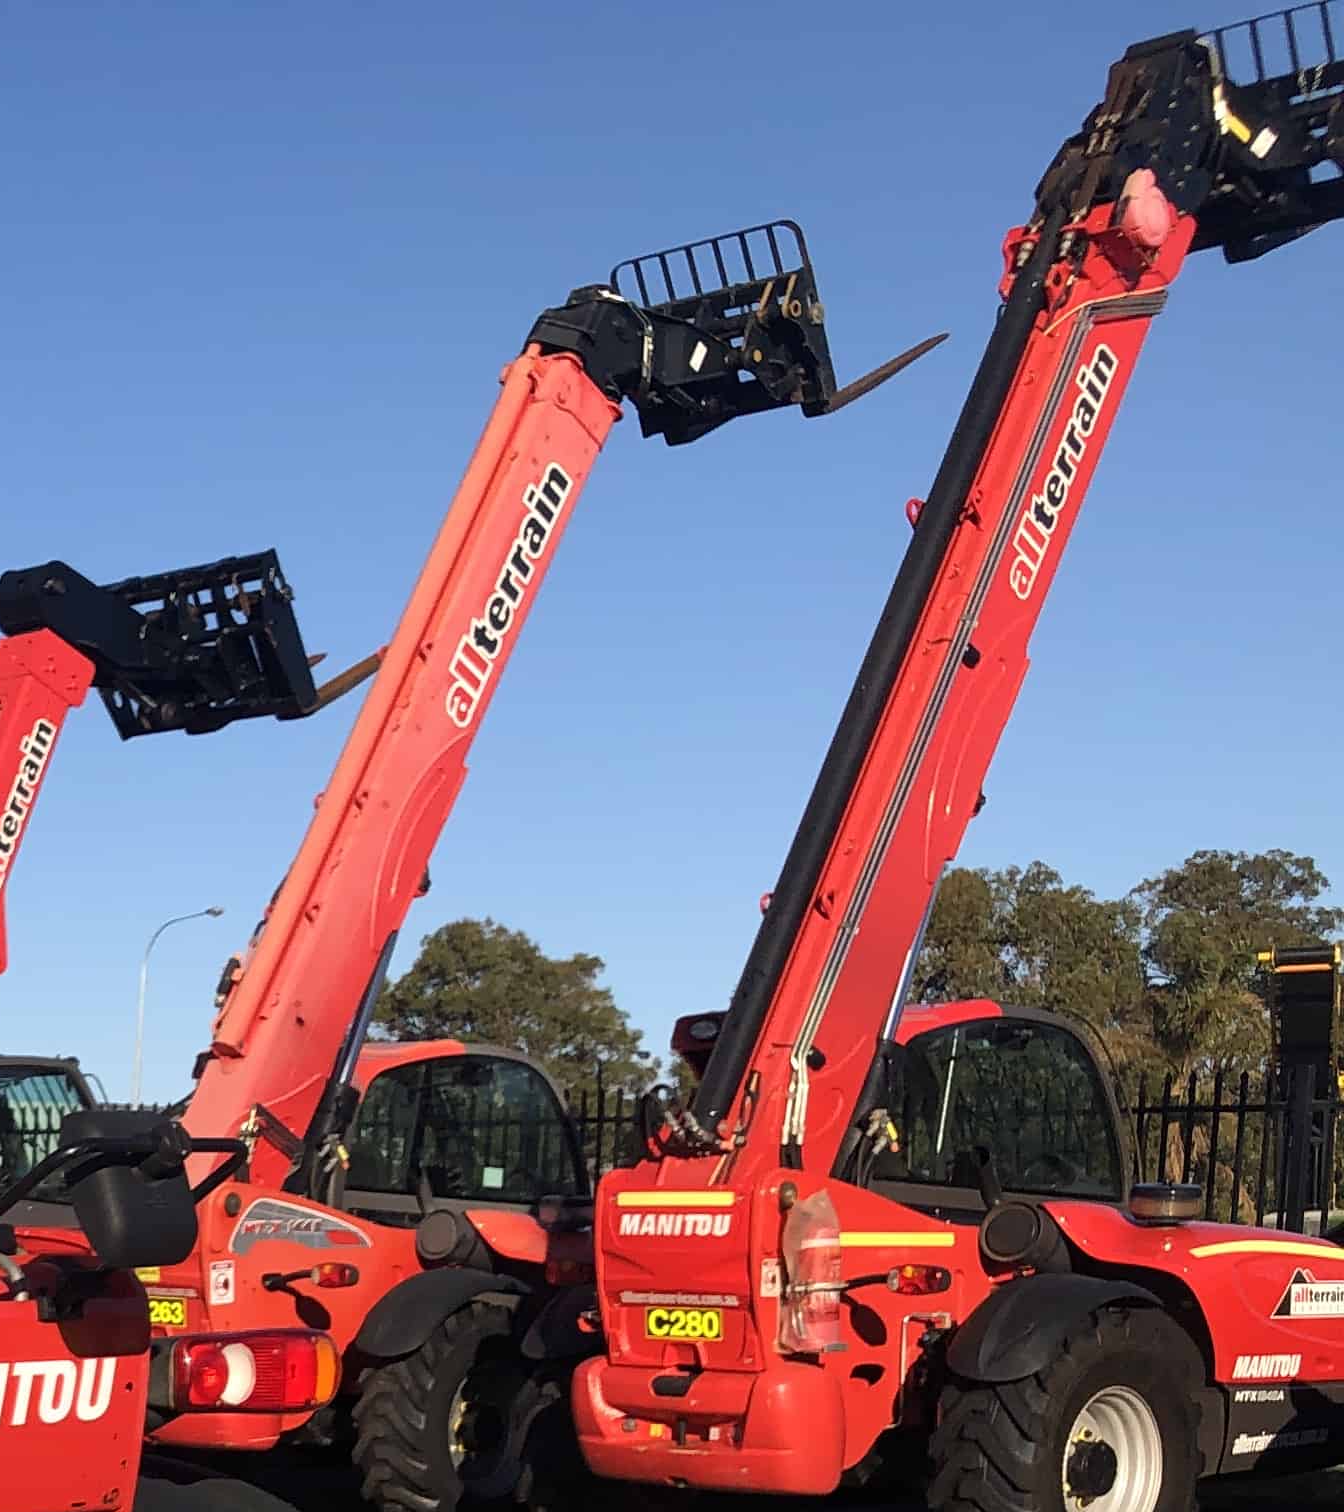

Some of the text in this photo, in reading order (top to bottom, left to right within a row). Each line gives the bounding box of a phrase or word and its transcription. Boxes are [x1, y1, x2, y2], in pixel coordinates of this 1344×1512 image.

[1010, 343, 1119, 600] allterrain
[446, 462, 573, 728] allterrain
[619, 1213, 733, 1237] MANITOU
[148, 1301, 184, 1324] 263
[648, 1309, 719, 1338] C280
[1232, 1354, 1302, 1379] MANITOU
